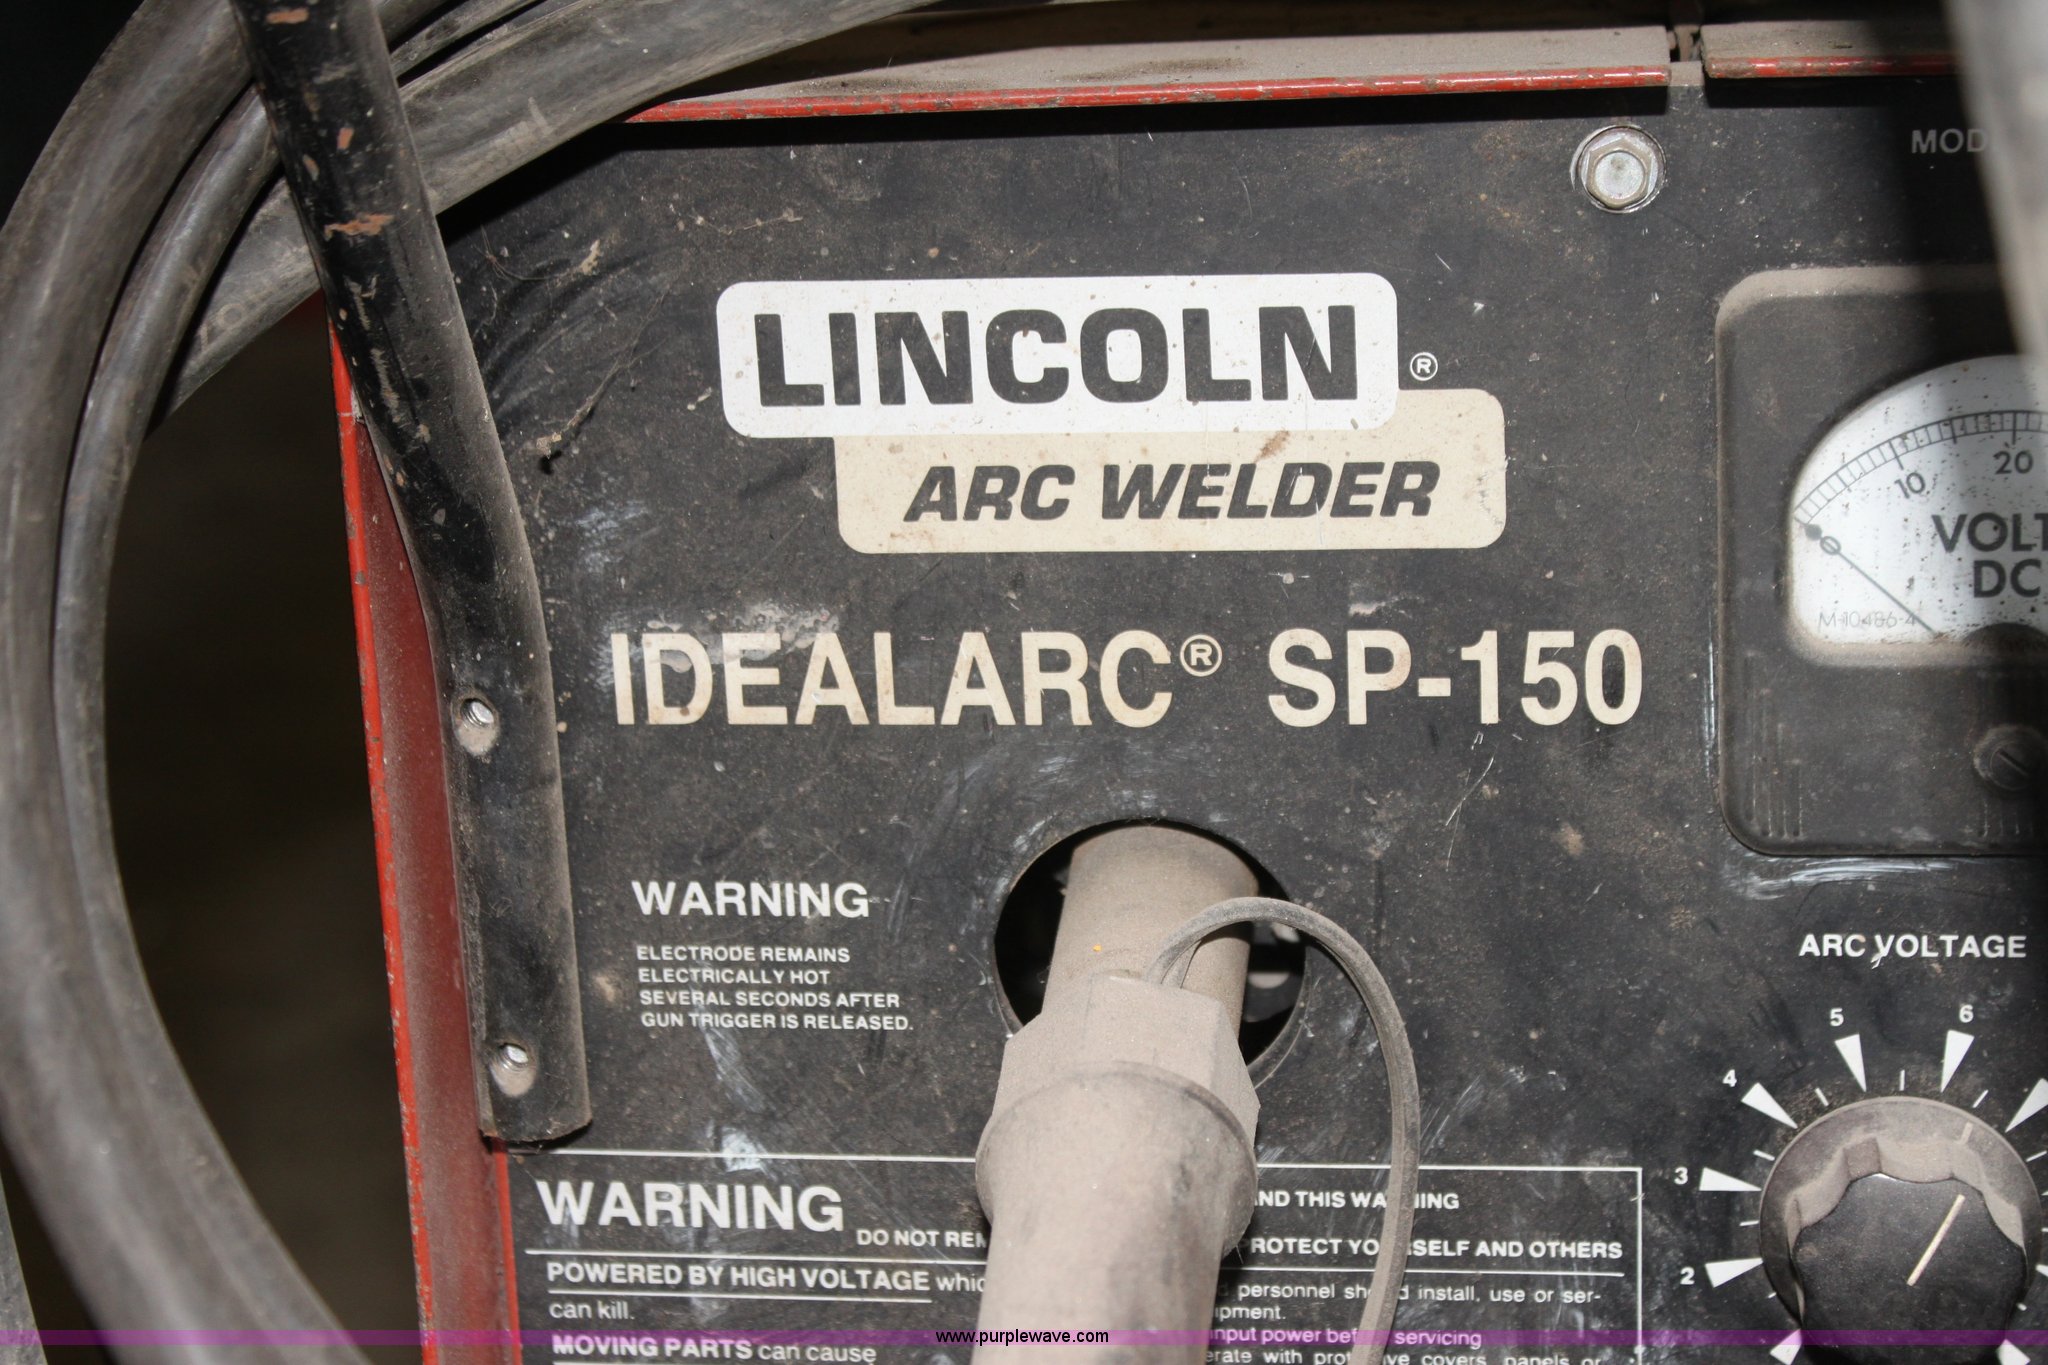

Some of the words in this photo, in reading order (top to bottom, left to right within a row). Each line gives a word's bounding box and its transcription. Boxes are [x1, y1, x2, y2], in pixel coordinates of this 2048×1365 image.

[1911, 128, 1990, 154] MOD
[753, 304, 1357, 407] LINCOLN
[1993, 450, 2033, 475] 20
[903, 464, 1077, 522] ARC
[1100, 460, 1440, 521] WELDER
[1894, 472, 1926, 499] 10
[1973, 558, 2041, 598] DC
[1267, 627, 1644, 729] SP-150
[631, 881, 869, 918] WARNING
[636, 945, 756, 962] ELECTRODE
[760, 946, 850, 963] REMAINS
[1799, 934, 1867, 957] ARC
[1876, 935, 2027, 959] VOLTAGE
[638, 968, 785, 984] ELECTRICALLY
[790, 969, 830, 985] HOT
[640, 990, 731, 1006] SEVERAL
[735, 991, 830, 1007] SECONDS
[836, 993, 900, 1008] AFTER
[641, 1014, 684, 1030] GUN
[690, 1015, 776, 1030] TRIGGER
[781, 1015, 799, 1030] IS
[803, 1016, 914, 1031] RELEASED.
[1830, 1009, 1844, 1027] 5
[1959, 1004, 1974, 1023] 6
[1722, 1070, 1737, 1087] 4
[1674, 1167, 1689, 1185] 3
[536, 1181, 844, 1233] WARNING
[1254, 1190, 1290, 1207] ND
[1295, 1191, 1346, 1208] THIS
[1351, 1192, 1459, 1210] WAING
[857, 1230, 889, 1246] DO
[894, 1231, 939, 1247] NOT
[945, 1231, 987, 1248] REM
[1347, 1239, 1470, 1258] YOSELF
[1475, 1241, 1524, 1257] AND
[1529, 1241, 1623, 1259] OTHERS
[547, 1262, 682, 1284] POWERED
[689, 1266, 723, 1286] BY
[731, 1267, 796, 1287] HIGH
[801, 1270, 931, 1290] VOLTAGE
[935, 1273, 986, 1292] whic
[1680, 1267, 1695, 1285] 2
[1238, 1284, 1335, 1300] personnel
[1344, 1284, 1409, 1300] shd
[1490, 1288, 1525, 1302] use
[1534, 1289, 1554, 1303] or
[1563, 1290, 1601, 1304] ser-
[549, 1301, 592, 1319] can
[597, 1301, 635, 1320] kill.
[1215, 1304, 1287, 1322] ipment.
[552, 1334, 659, 1357] MOVING
[664, 1337, 752, 1360] PARTS
[757, 1346, 801, 1360] can
[806, 1345, 877, 1362] cause
[1261, 1330, 1321, 1345] power
[1326, 1328, 1357, 1344] bef
[1395, 1331, 1482, 1350] servicing
[1206, 1350, 1253, 1364] erate
[1263, 1351, 1303, 1365] with
